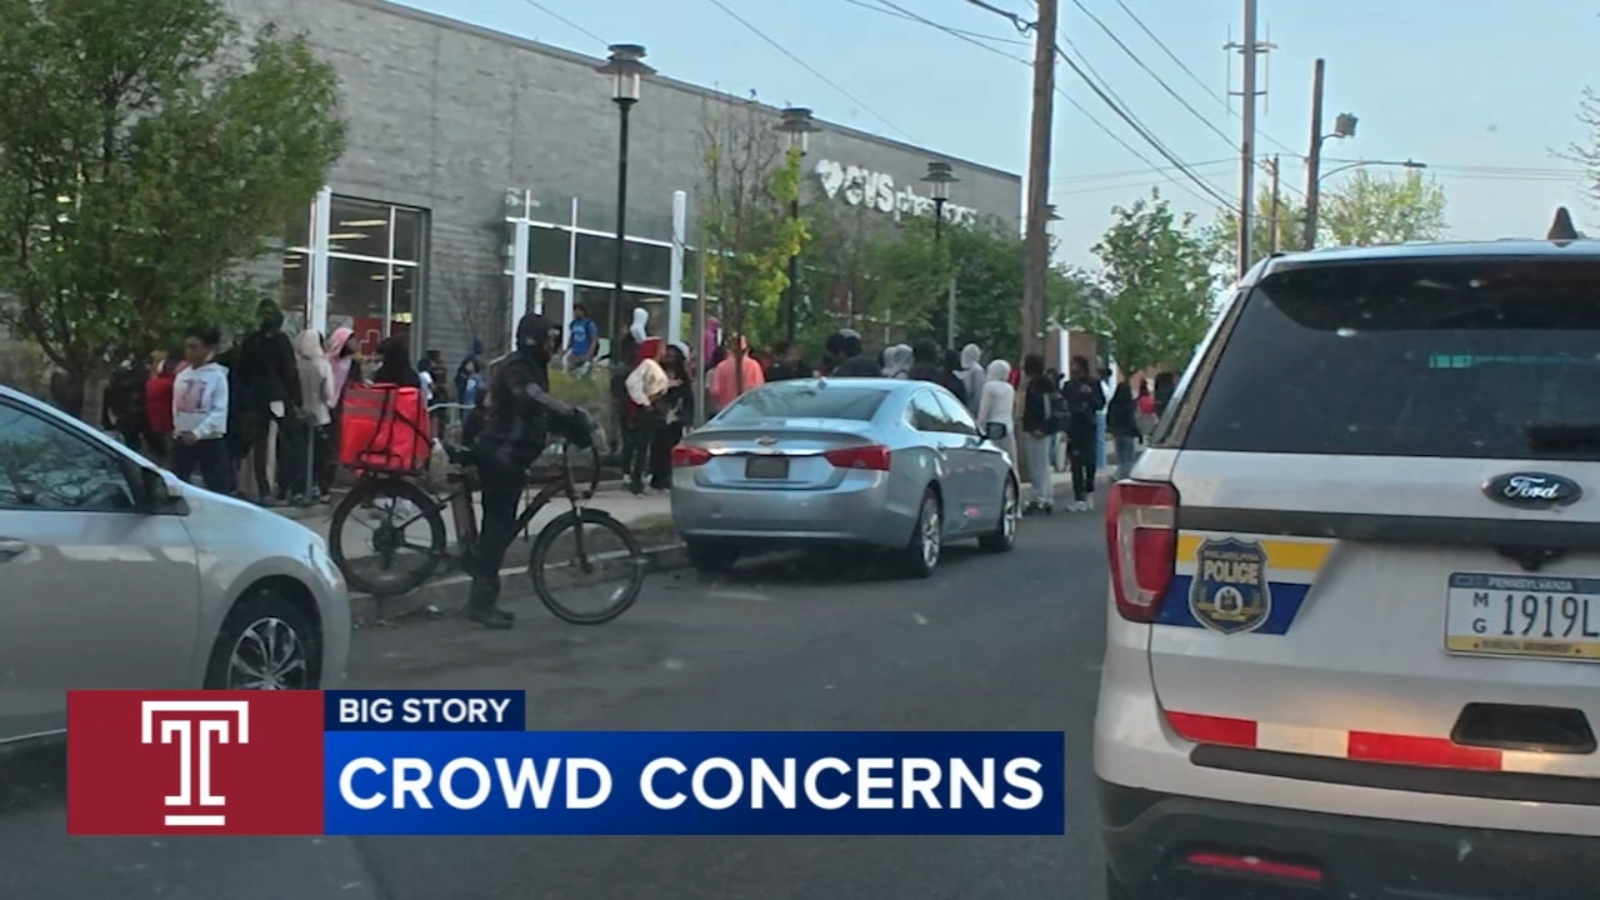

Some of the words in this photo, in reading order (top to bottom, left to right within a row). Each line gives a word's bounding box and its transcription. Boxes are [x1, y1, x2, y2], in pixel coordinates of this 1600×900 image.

[842, 165, 895, 213] CVS
[1504, 475, 1560, 499] Ford
[1203, 559, 1260, 585] POLICE
[1473, 592, 1489, 608] M
[1472, 618, 1487, 634] G
[1502, 594, 1600, 638] 1919L
